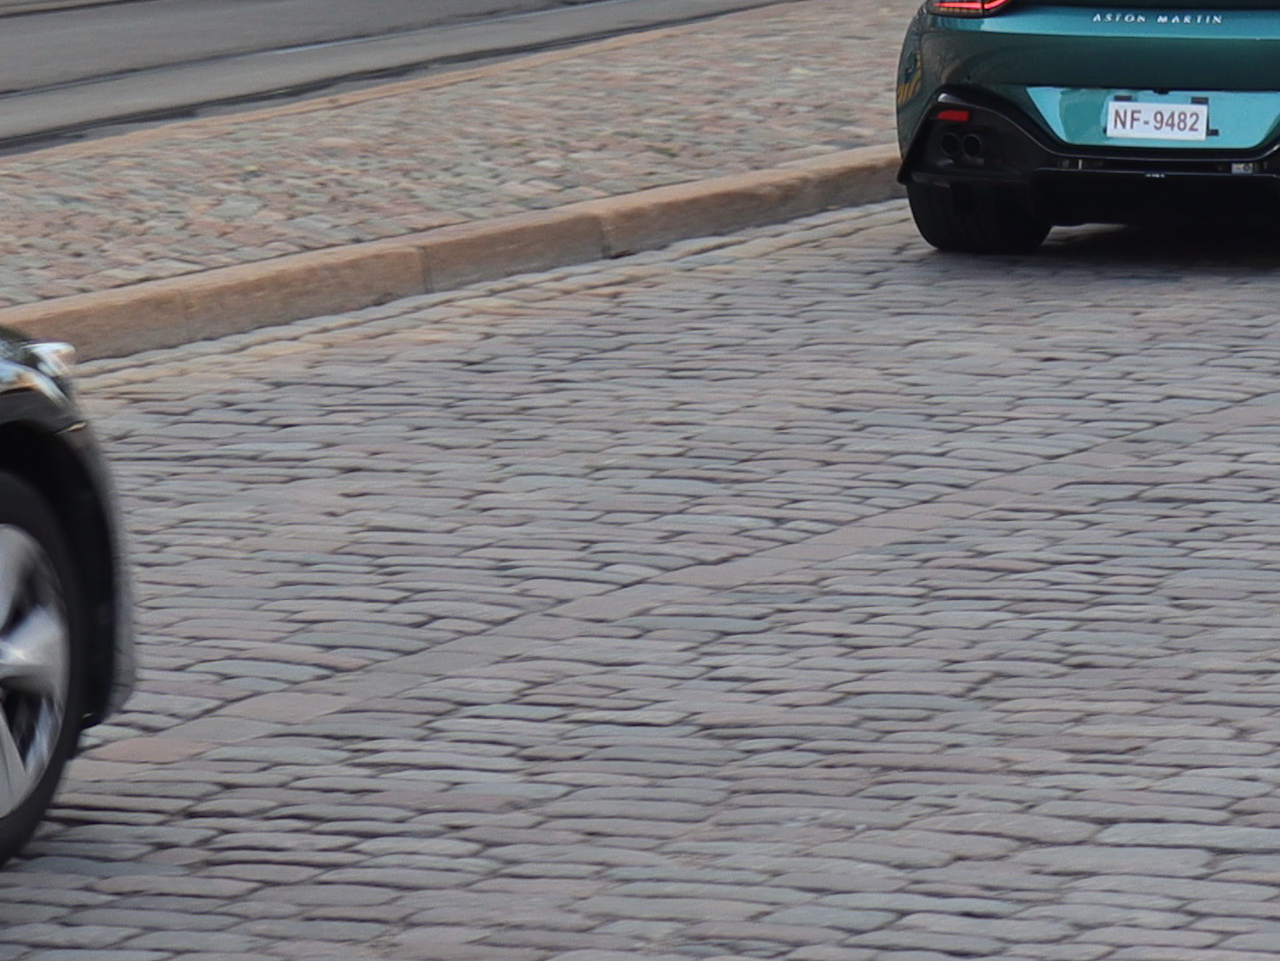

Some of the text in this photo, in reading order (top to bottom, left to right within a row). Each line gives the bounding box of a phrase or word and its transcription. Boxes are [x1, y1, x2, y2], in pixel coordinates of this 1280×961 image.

[1092, 13, 1222, 24] ASTON MARTIN
[1113, 109, 1200, 132] NF-9482
